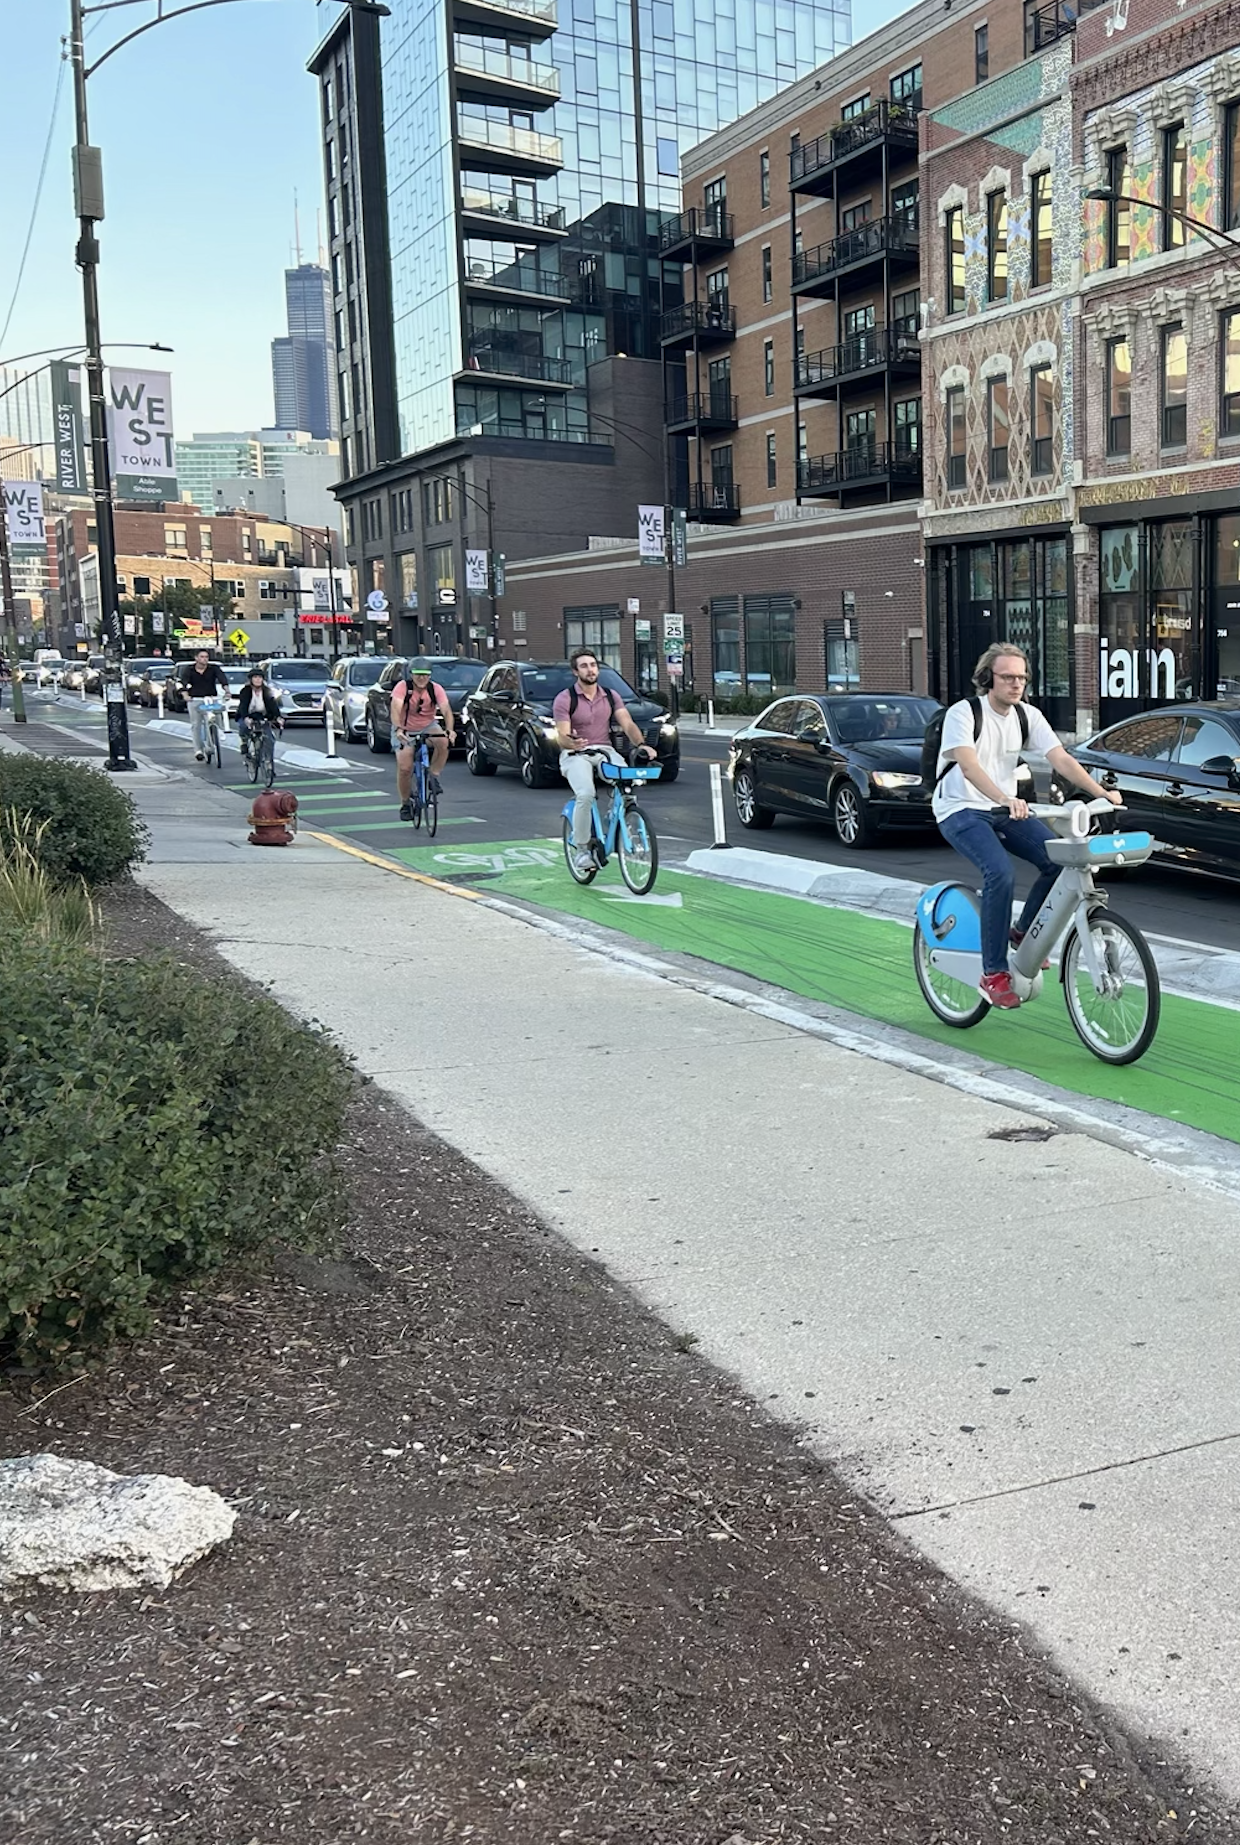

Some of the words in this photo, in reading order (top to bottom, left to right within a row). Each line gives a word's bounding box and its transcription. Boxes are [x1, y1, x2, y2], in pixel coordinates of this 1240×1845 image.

[58, 404, 72, 442] WEST
[60, 448, 75, 488] RIVER
[121, 455, 162, 467] TOWN
[667, 626, 682, 636] 25
